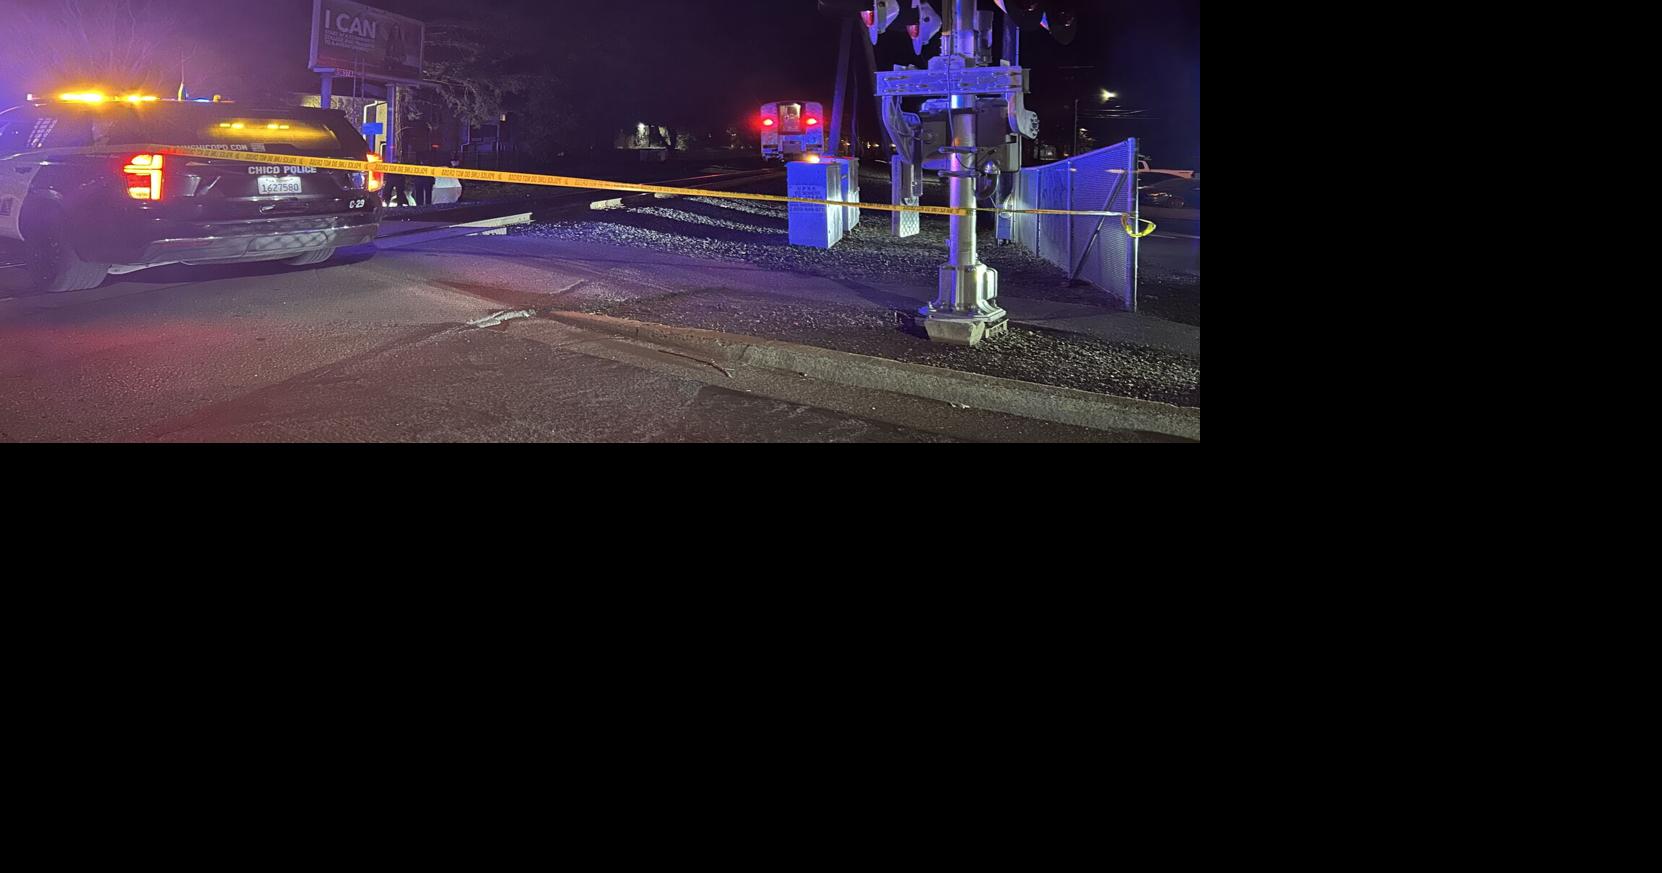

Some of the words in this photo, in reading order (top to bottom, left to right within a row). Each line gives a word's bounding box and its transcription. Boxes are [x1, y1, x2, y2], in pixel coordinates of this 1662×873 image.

[325, 10, 330, 28] I
[336, 13, 376, 38] CAN
[248, 166, 280, 174] CHICO
[284, 165, 317, 173] POLICE
[262, 183, 299, 192] 1627580
[349, 200, 365, 208] C-29
